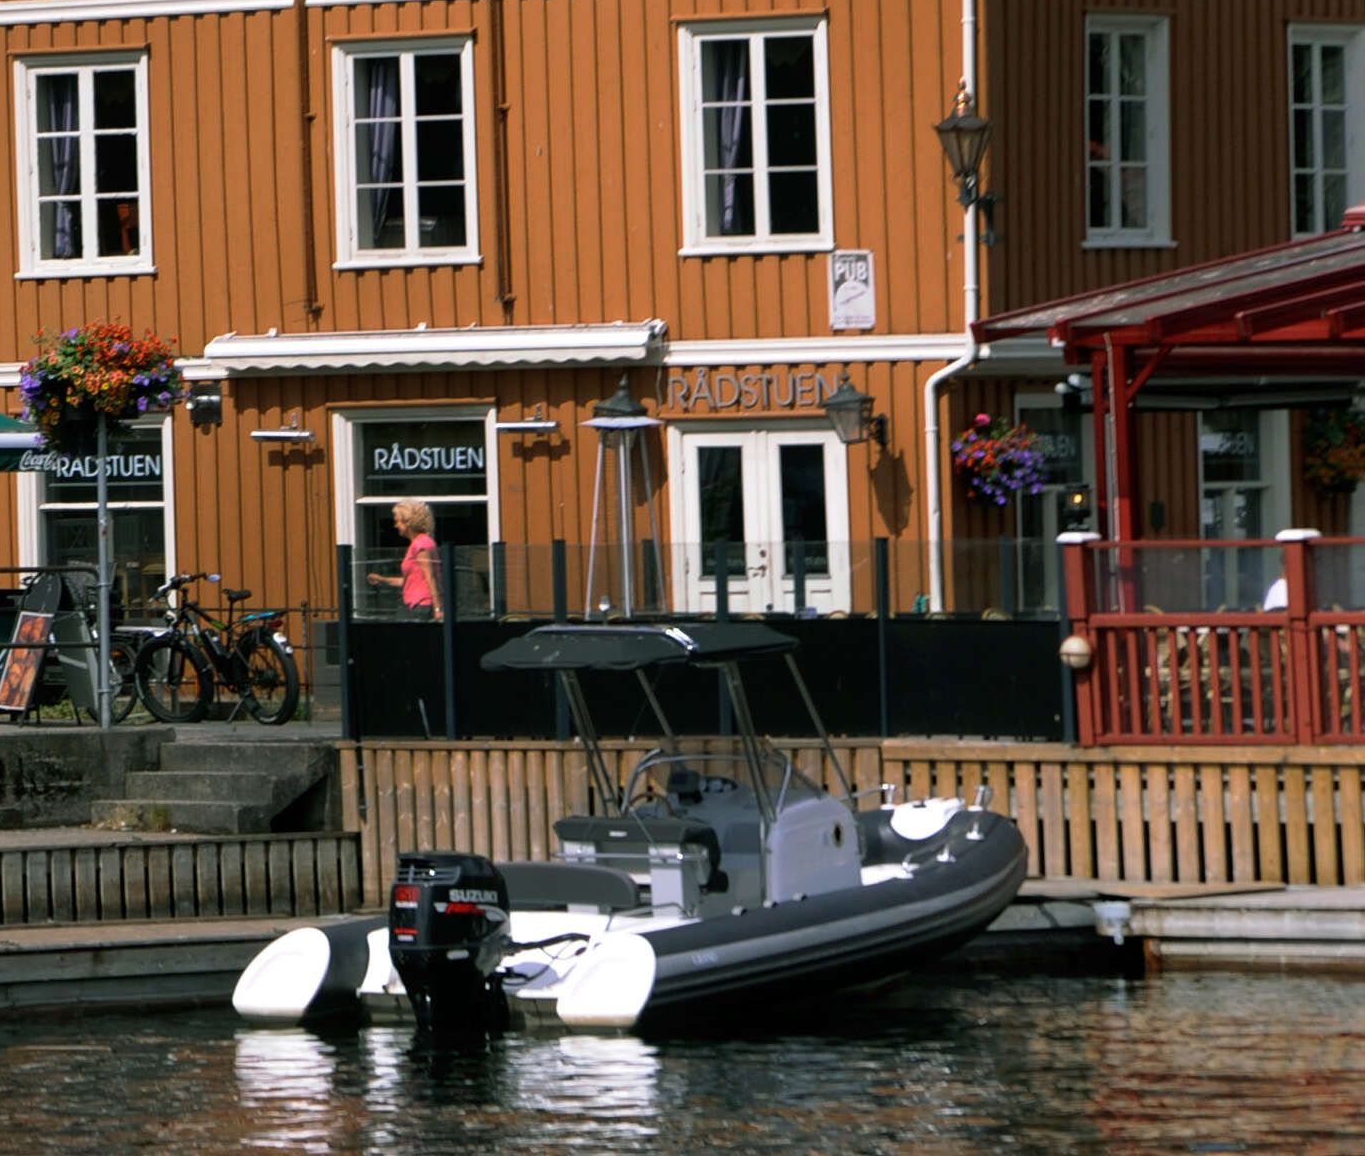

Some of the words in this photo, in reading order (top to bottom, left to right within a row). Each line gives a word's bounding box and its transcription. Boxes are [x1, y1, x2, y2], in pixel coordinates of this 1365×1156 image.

[834, 260, 868, 281] PUB
[668, 367, 839, 410] RÅDSTUEN
[374, 442, 484, 470] RÅDSTUEN
[449, 889, 498, 903] SUZUKI
